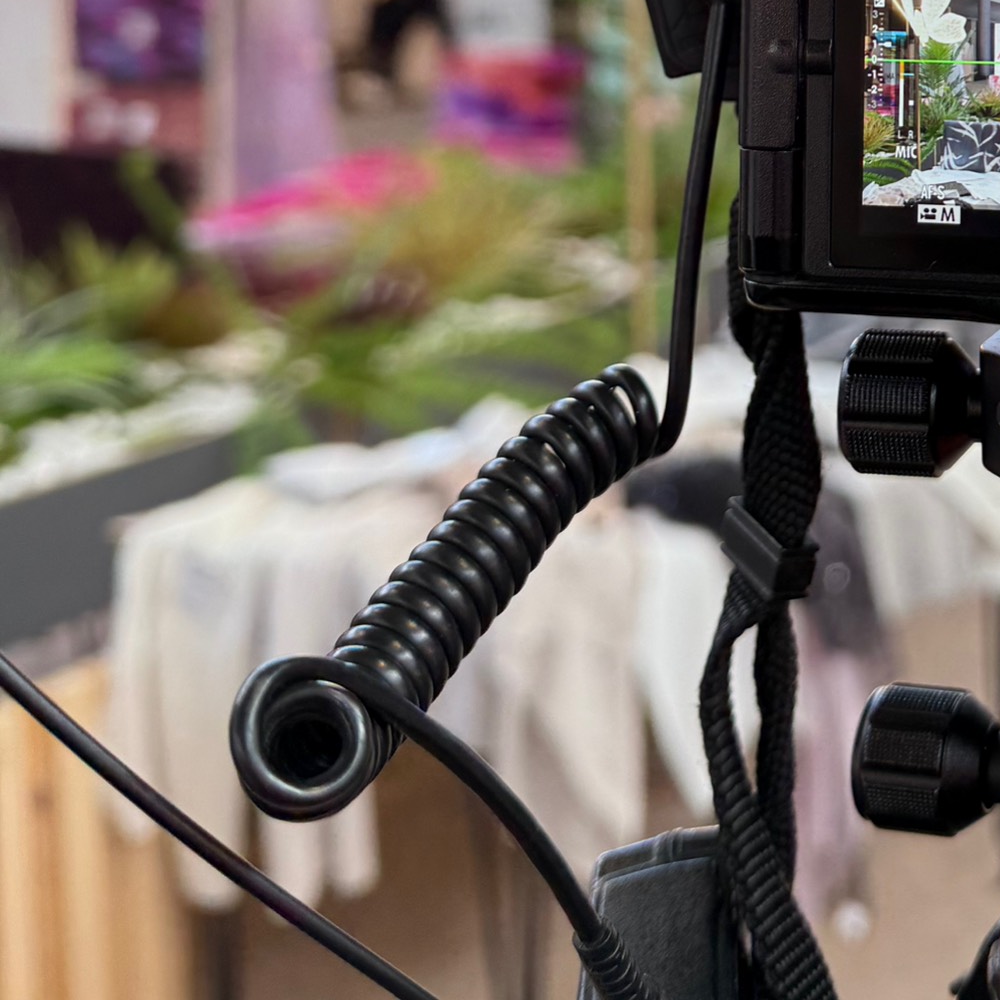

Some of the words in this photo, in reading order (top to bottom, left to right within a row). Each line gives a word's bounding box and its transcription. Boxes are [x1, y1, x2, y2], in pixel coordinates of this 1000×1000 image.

[872, 9, 879, 19] 3
[872, 24, 879, 33] 2
[872, 40, 877, 49] 1
[895, 145, 918, 158] MIC
[920, 185, 945, 200] AF-S
[940, 207, 955, 222] M
